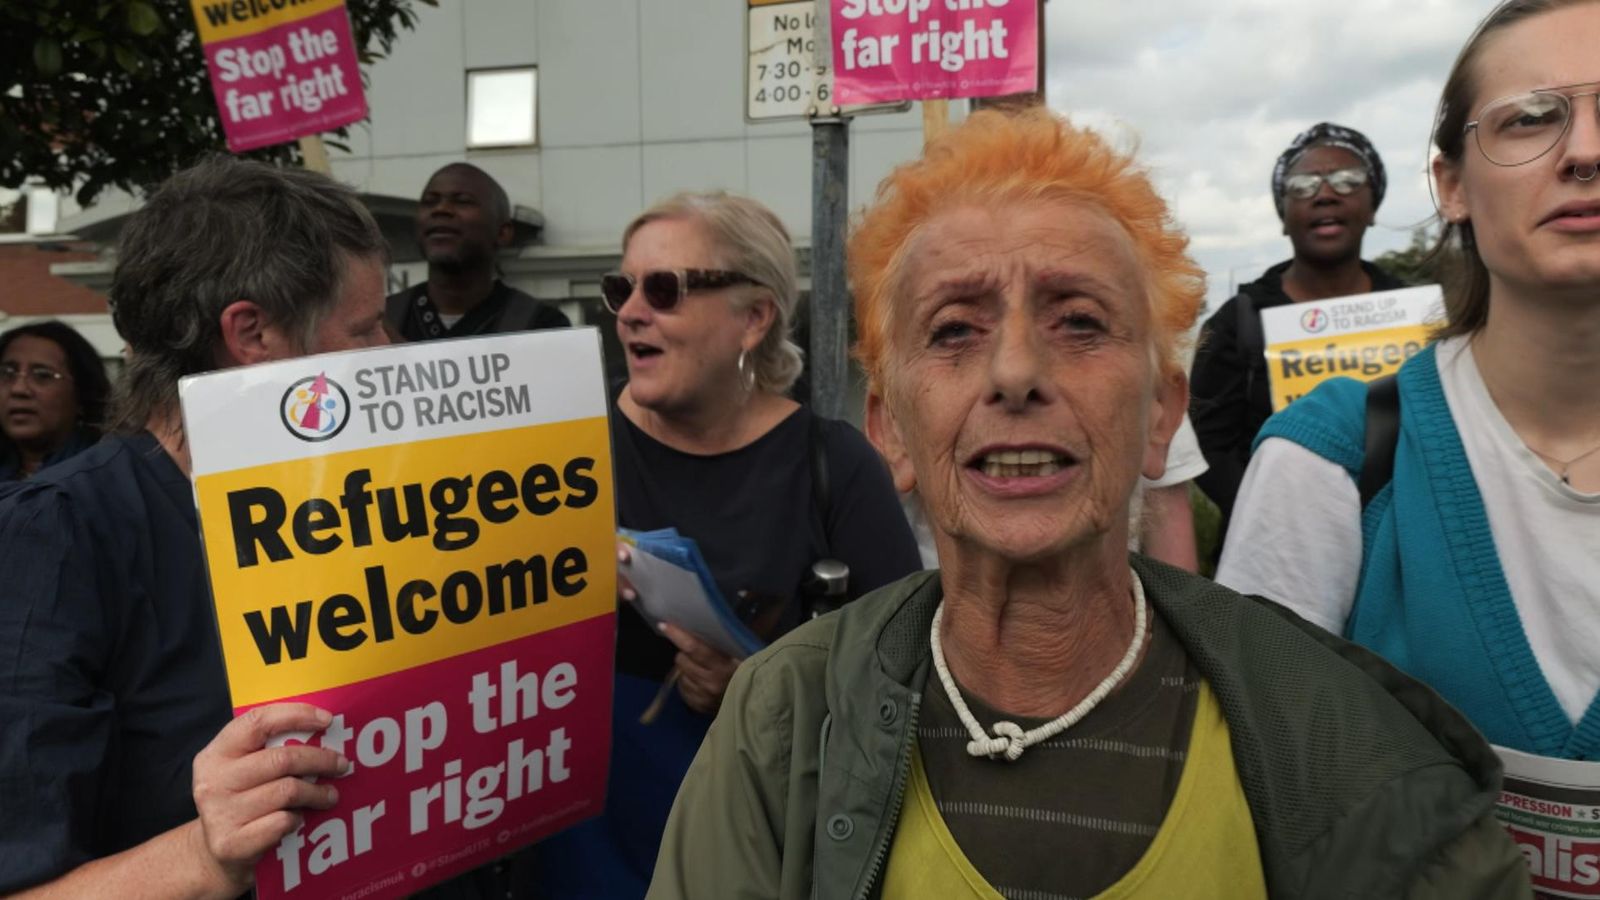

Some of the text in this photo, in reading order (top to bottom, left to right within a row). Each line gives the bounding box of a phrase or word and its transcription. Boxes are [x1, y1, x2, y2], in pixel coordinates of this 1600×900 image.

[204, 0, 311, 27] welc
[774, 14, 800, 31] No
[215, 27, 339, 82] Stop the
[841, 19, 1009, 72] far right
[225, 64, 347, 123] far right
[354, 353, 512, 398] STAND UP
[1280, 341, 1424, 379] Refugee
[359, 384, 532, 433] TO RACISM
[227, 456, 599, 569] Refugees
[243, 547, 589, 665] welcome
[265, 660, 578, 783] top the
[276, 727, 572, 892] far right
